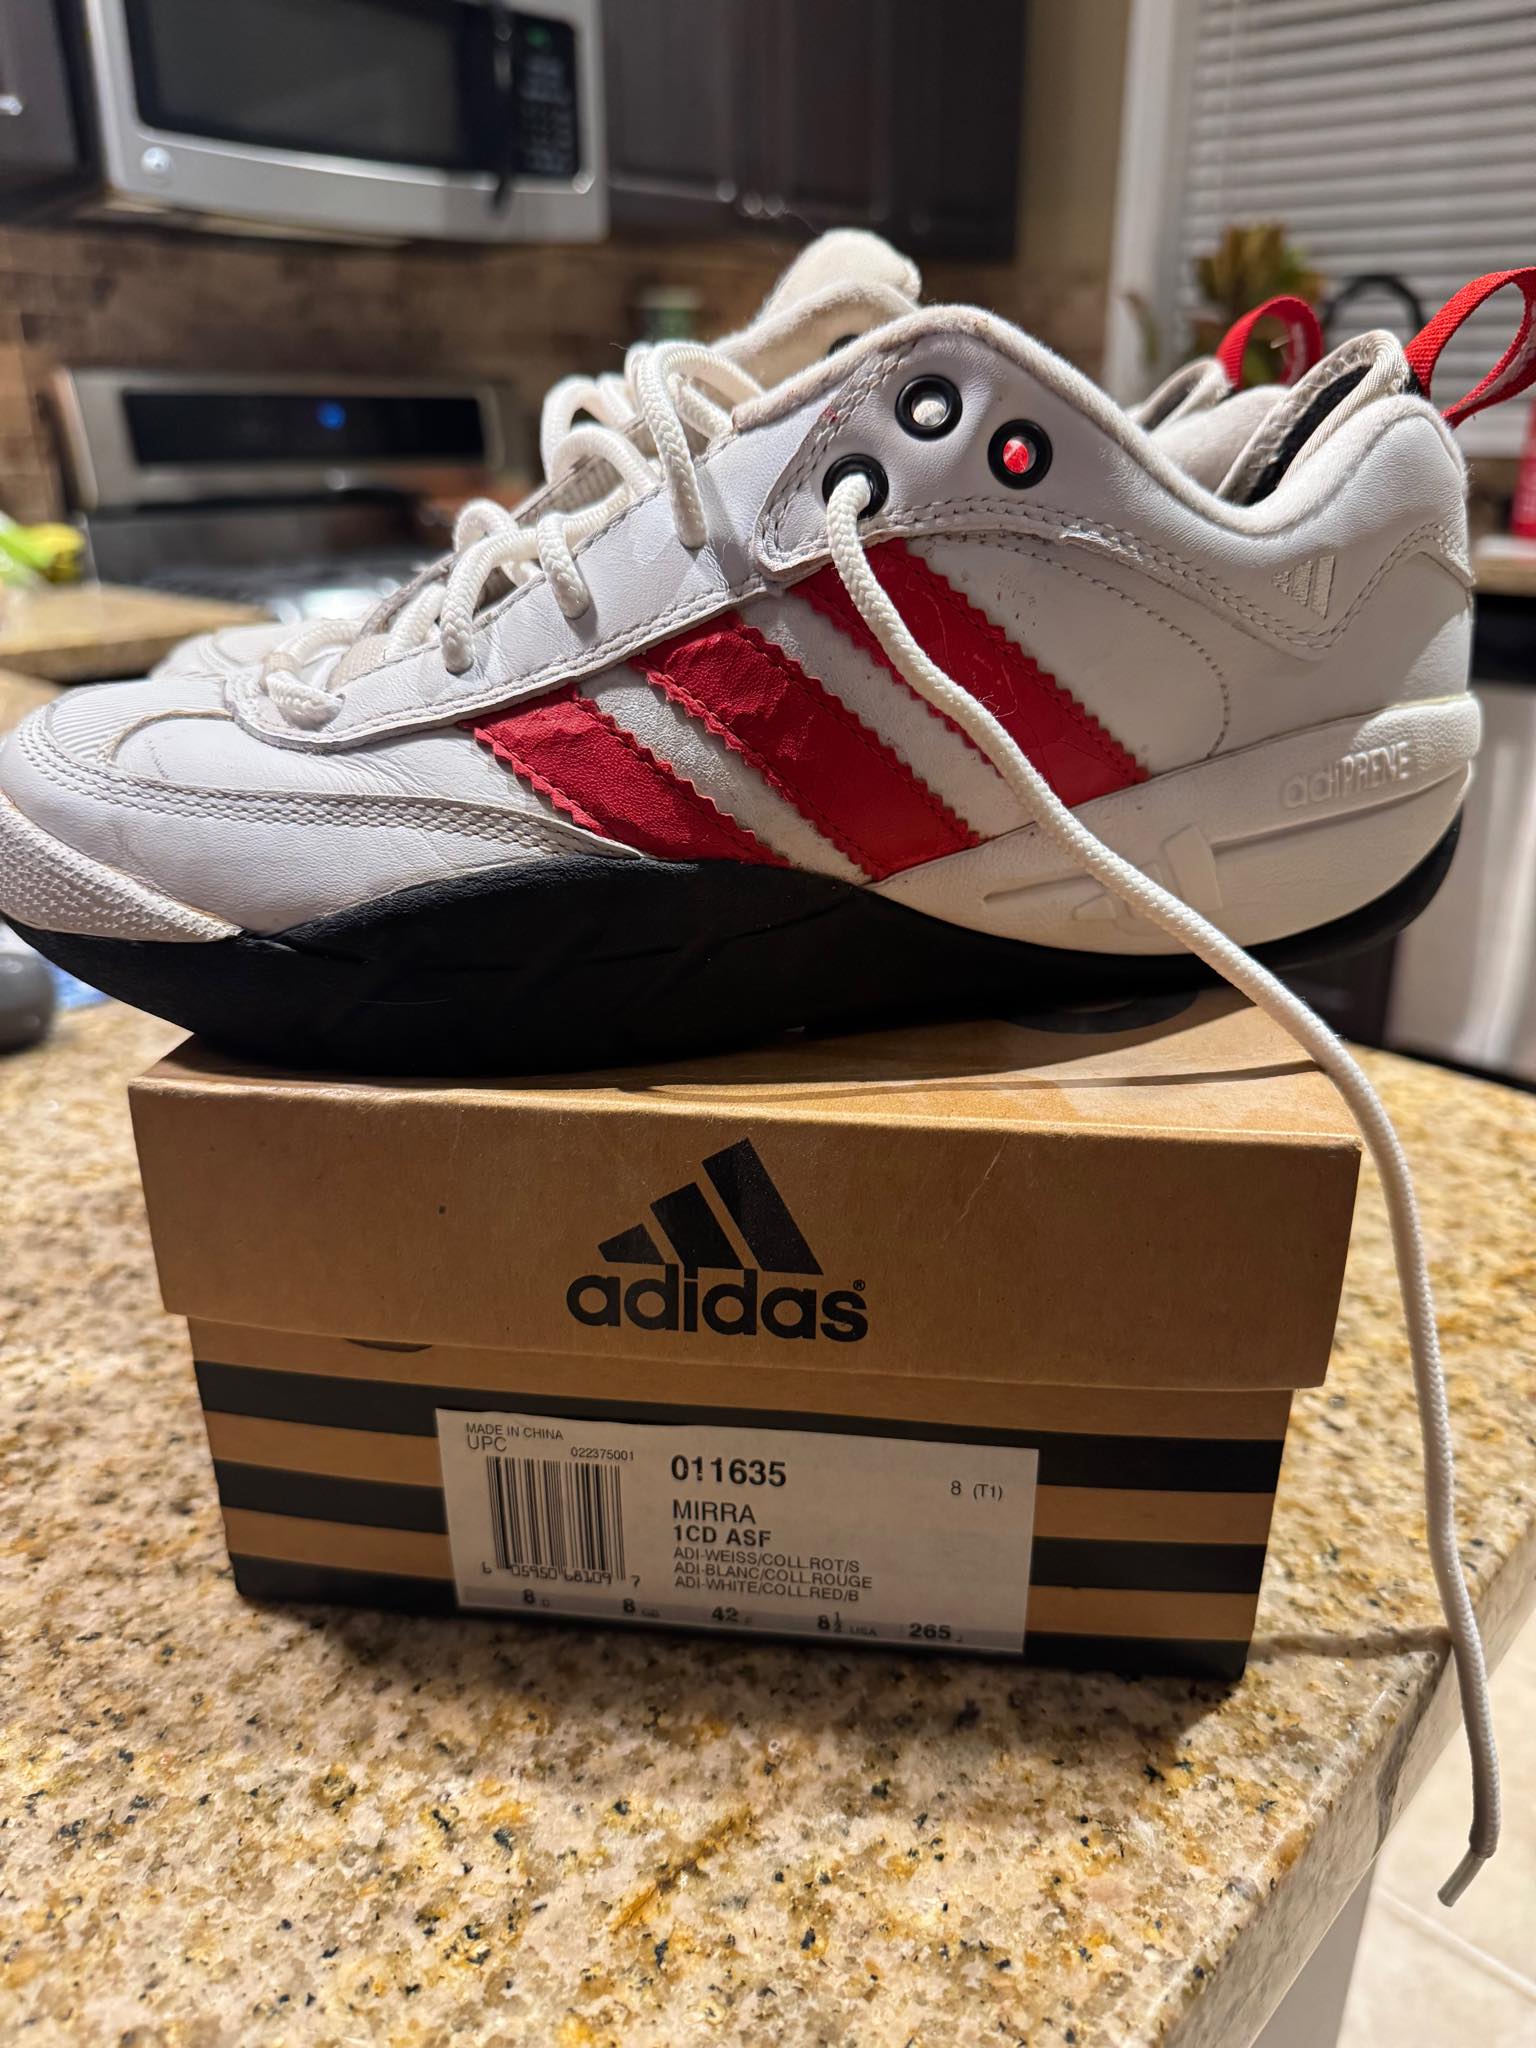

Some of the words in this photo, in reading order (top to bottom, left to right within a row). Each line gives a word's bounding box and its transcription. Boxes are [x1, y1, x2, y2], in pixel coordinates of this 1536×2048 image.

[566, 1263, 869, 1342] adidas
[466, 1423, 503, 1436] MADE
[507, 1426, 520, 1438] IN
[523, 1427, 564, 1441] CHINA
[467, 1436, 507, 1452] UPC
[570, 1447, 635, 1461] 022375001
[671, 1454, 786, 1487] 011635
[950, 1480, 962, 1496] 8
[973, 1482, 1003, 1501] (T1)
[672, 1498, 757, 1525] MIRRA
[673, 1525, 716, 1544] 1CD
[726, 1528, 772, 1548] ASF
[631, 1575, 641, 1588] 7
[711, 1606, 738, 1623] 42
[909, 1622, 952, 1640] 265
